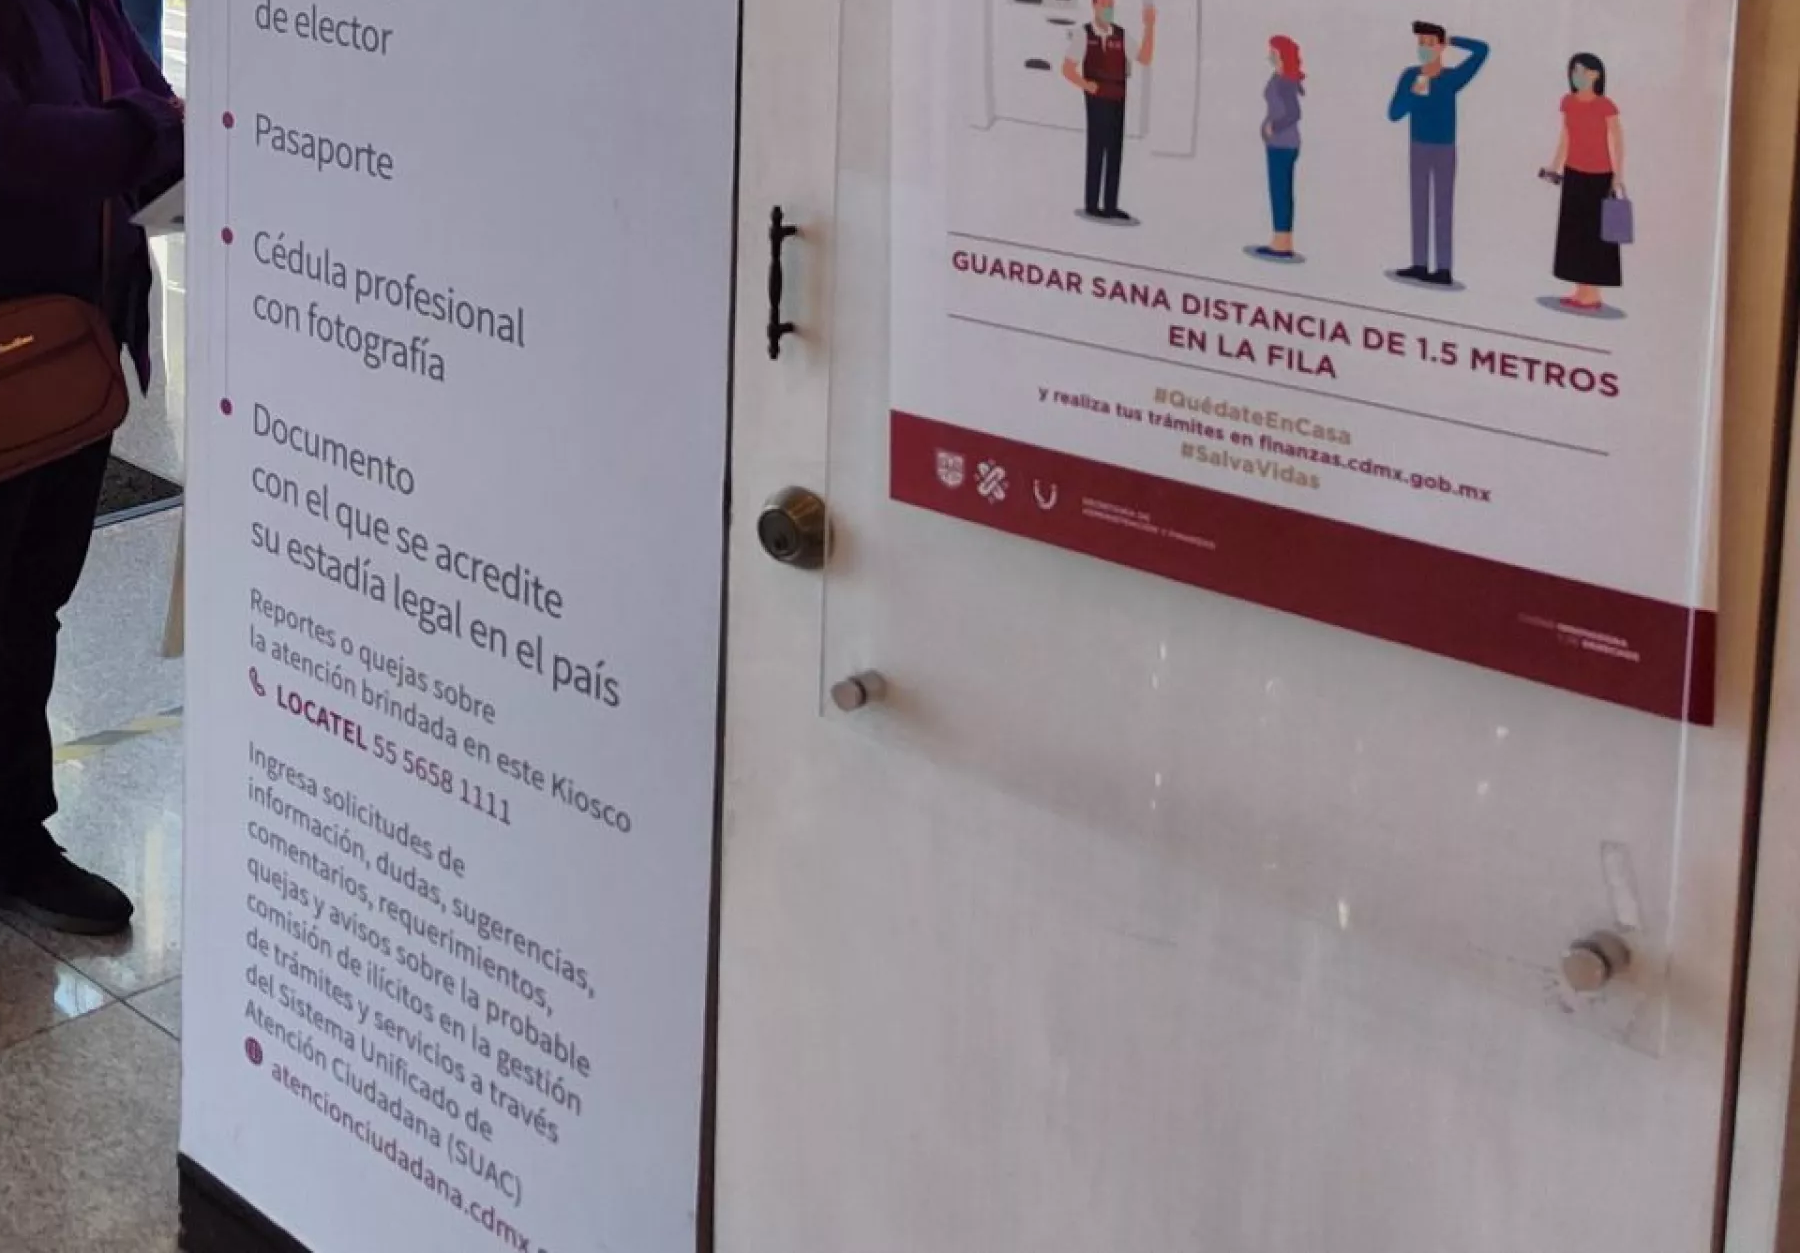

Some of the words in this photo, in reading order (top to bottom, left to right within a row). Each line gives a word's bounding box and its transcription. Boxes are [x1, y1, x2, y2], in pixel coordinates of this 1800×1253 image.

[294, 3, 393, 56] elector
[256, 112, 393, 180] Pasaporte
[252, 294, 301, 332] con
[307, 301, 445, 383] fotografía
[254, 231, 347, 290] Cédula
[355, 268, 525, 348] profesional
[952, 250, 1083, 294] GUARDAR
[1092, 276, 1171, 311] SANA
[1182, 293, 1351, 345] DISTANCIA
[1362, 326, 1405, 356] DE
[1417, 337, 1458, 366] 1.5
[1471, 347, 1619, 398] METROS
[1169, 324, 1207, 353] EN
[1218, 334, 1256, 363] LA
[1267, 344, 1336, 379] FILA
[254, 402, 415, 495] Documento
[1038, 387, 1049, 402] y
[1053, 390, 1111, 414] realiza
[1115, 402, 1143, 422] tus
[1148, 410, 1224, 440] trámites
[1229, 431, 1253, 446] en
[1259, 434, 1491, 502] finanzas.cdmx.gob.mx
[1154, 386, 1351, 446] #QuédateEnCasa
[1180, 441, 1321, 491] #SalvaVidas
[251, 521, 280, 555] su
[286, 538, 386, 602] estadía
[394, 573, 462, 638] legal
[470, 619, 507, 658] en
[516, 635, 543, 675] el
[552, 654, 620, 707] país
[252, 467, 299, 507] con
[305, 484, 329, 521] el
[335, 502, 389, 546] que
[396, 526, 429, 562] se
[435, 543, 563, 619] acredite
[249, 585, 337, 649] Reportes
[340, 637, 354, 656] o
[359, 645, 429, 693] quejas
[432, 679, 496, 725] sobre
[250, 623, 267, 653] la
[271, 641, 356, 698] atención
[361, 678, 457, 749] brindada
[463, 736, 491, 764] en
[496, 753, 545, 791] este
[551, 772, 631, 833] Kiosco
[276, 684, 368, 751] LOCATEL
[372, 734, 397, 765] 55
[402, 749, 453, 795] 5658
[460, 778, 511, 826] 1111
[249, 741, 318, 798] Ingresa
[322, 786, 434, 861] solicitudes
[438, 845, 466, 879] de
[247, 821, 374, 911] comentarios,
[378, 896, 553, 1018] requerimientos,
[248, 776, 371, 870] información,
[376, 851, 447, 914] dudas,
[452, 897, 594, 999] sugerencias,
[246, 893, 332, 959] comisión
[336, 946, 362, 978] de
[366, 960, 434, 1023] ilícitos
[439, 1012, 466, 1042] en
[471, 1025, 492, 1059] la
[496, 1048, 581, 1117] gestión
[246, 926, 269, 958] de
[273, 944, 354, 1012] trámites
[357, 999, 370, 1025] y
[374, 1010, 466, 1084] servicios
[470, 1073, 483, 1096] a
[489, 1080, 559, 1144] través
[247, 857, 309, 907] quejas
[312, 895, 327, 921] y
[329, 905, 391, 956] avisos
[396, 945, 455, 996] sobre
[460, 976, 480, 1011] la
[486, 999, 591, 1078] probable
[244, 998, 327, 1070] Atención
[331, 1057, 441, 1148] Ciudadana
[447, 1132, 522, 1208] (SUAC)
[245, 964, 274, 999] del
[279, 983, 355, 1052] Sistema
[361, 1034, 460, 1119] Unificado
[464, 1107, 493, 1142] de
